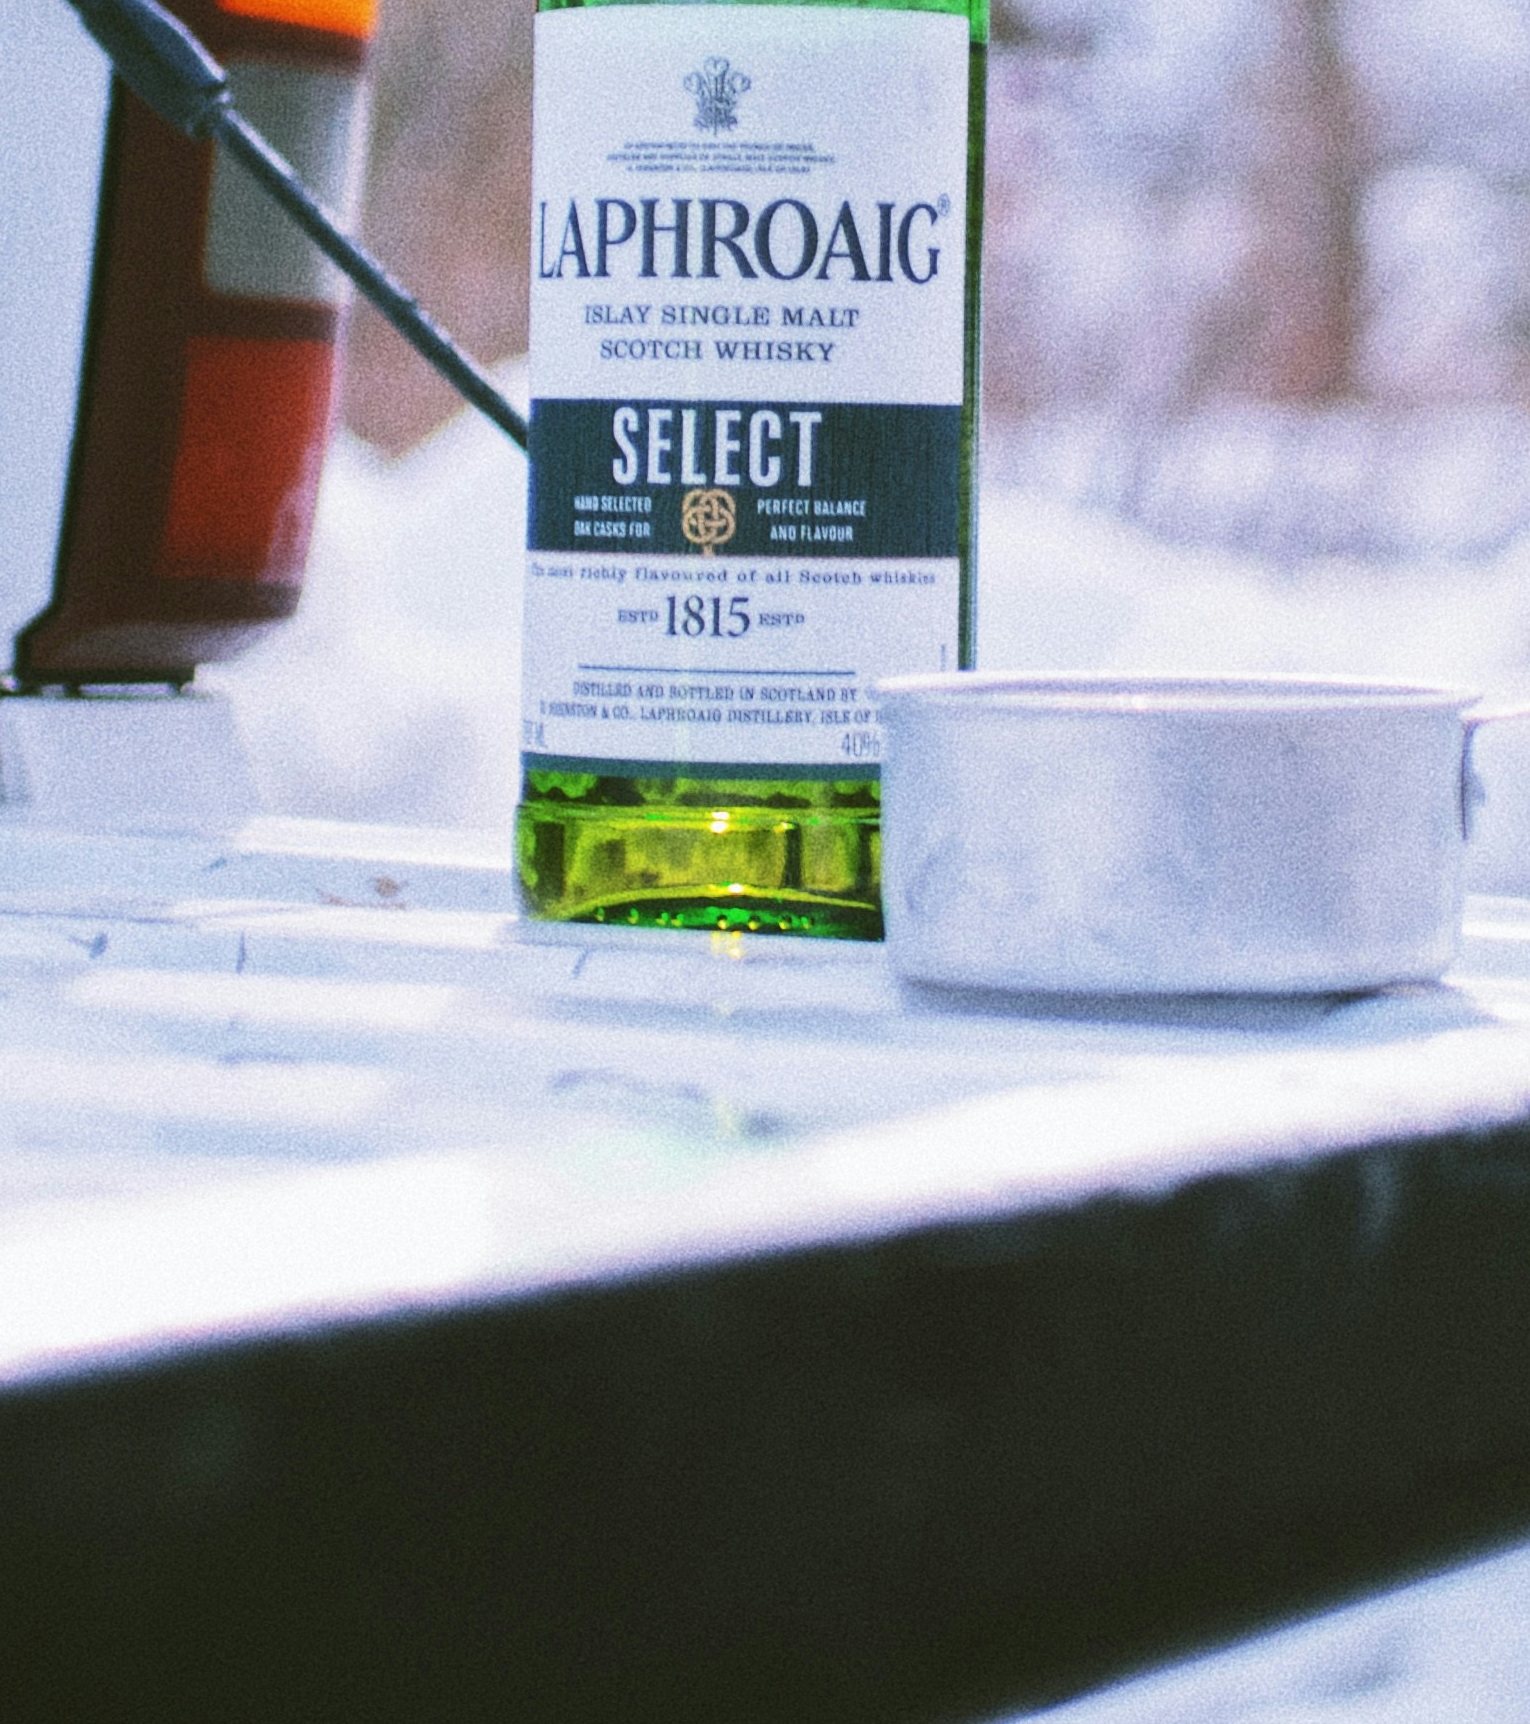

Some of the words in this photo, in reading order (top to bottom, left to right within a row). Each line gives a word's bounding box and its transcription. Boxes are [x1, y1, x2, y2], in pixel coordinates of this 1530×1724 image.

[584, 304, 651, 326] ISLAY
[661, 305, 770, 327] SINGLE
[782, 307, 860, 329] MALT
[600, 338, 703, 361] SCOTCH
[715, 340, 835, 363] WHISKY
[612, 405, 823, 488] SELECT
[574, 495, 599, 512] HAND
[601, 495, 653, 513] SELECTED
[757, 498, 810, 516] PERFECT
[814, 500, 867, 517] BALANCE
[574, 520, 592, 537] OAK
[594, 521, 627, 538] CASKS
[629, 522, 651, 538] FOR
[770, 524, 797, 542] AND
[800, 525, 854, 542] FLAVOUR
[580, 566, 627, 584] richly
[635, 566, 728, 583] flavoured
[736, 569, 757, 584] of
[765, 569, 790, 584] all
[799, 570, 862, 585] Scotch
[870, 571, 937, 586] whiskies
[617, 608, 659, 624] ESTD
[665, 594, 751, 638] 1815
[758, 612, 806, 627] ESTD
[637, 684, 664, 700] AND
[669, 685, 734, 702] BOTTLED
[740, 687, 754, 701] IN
[760, 687, 836, 703] SCOTLAND
[840, 688, 857, 702] BY
[640, 706, 722, 723] LAPHROAIG
[821, 710, 850, 725] ISLE
[854, 710, 871, 725] OF
